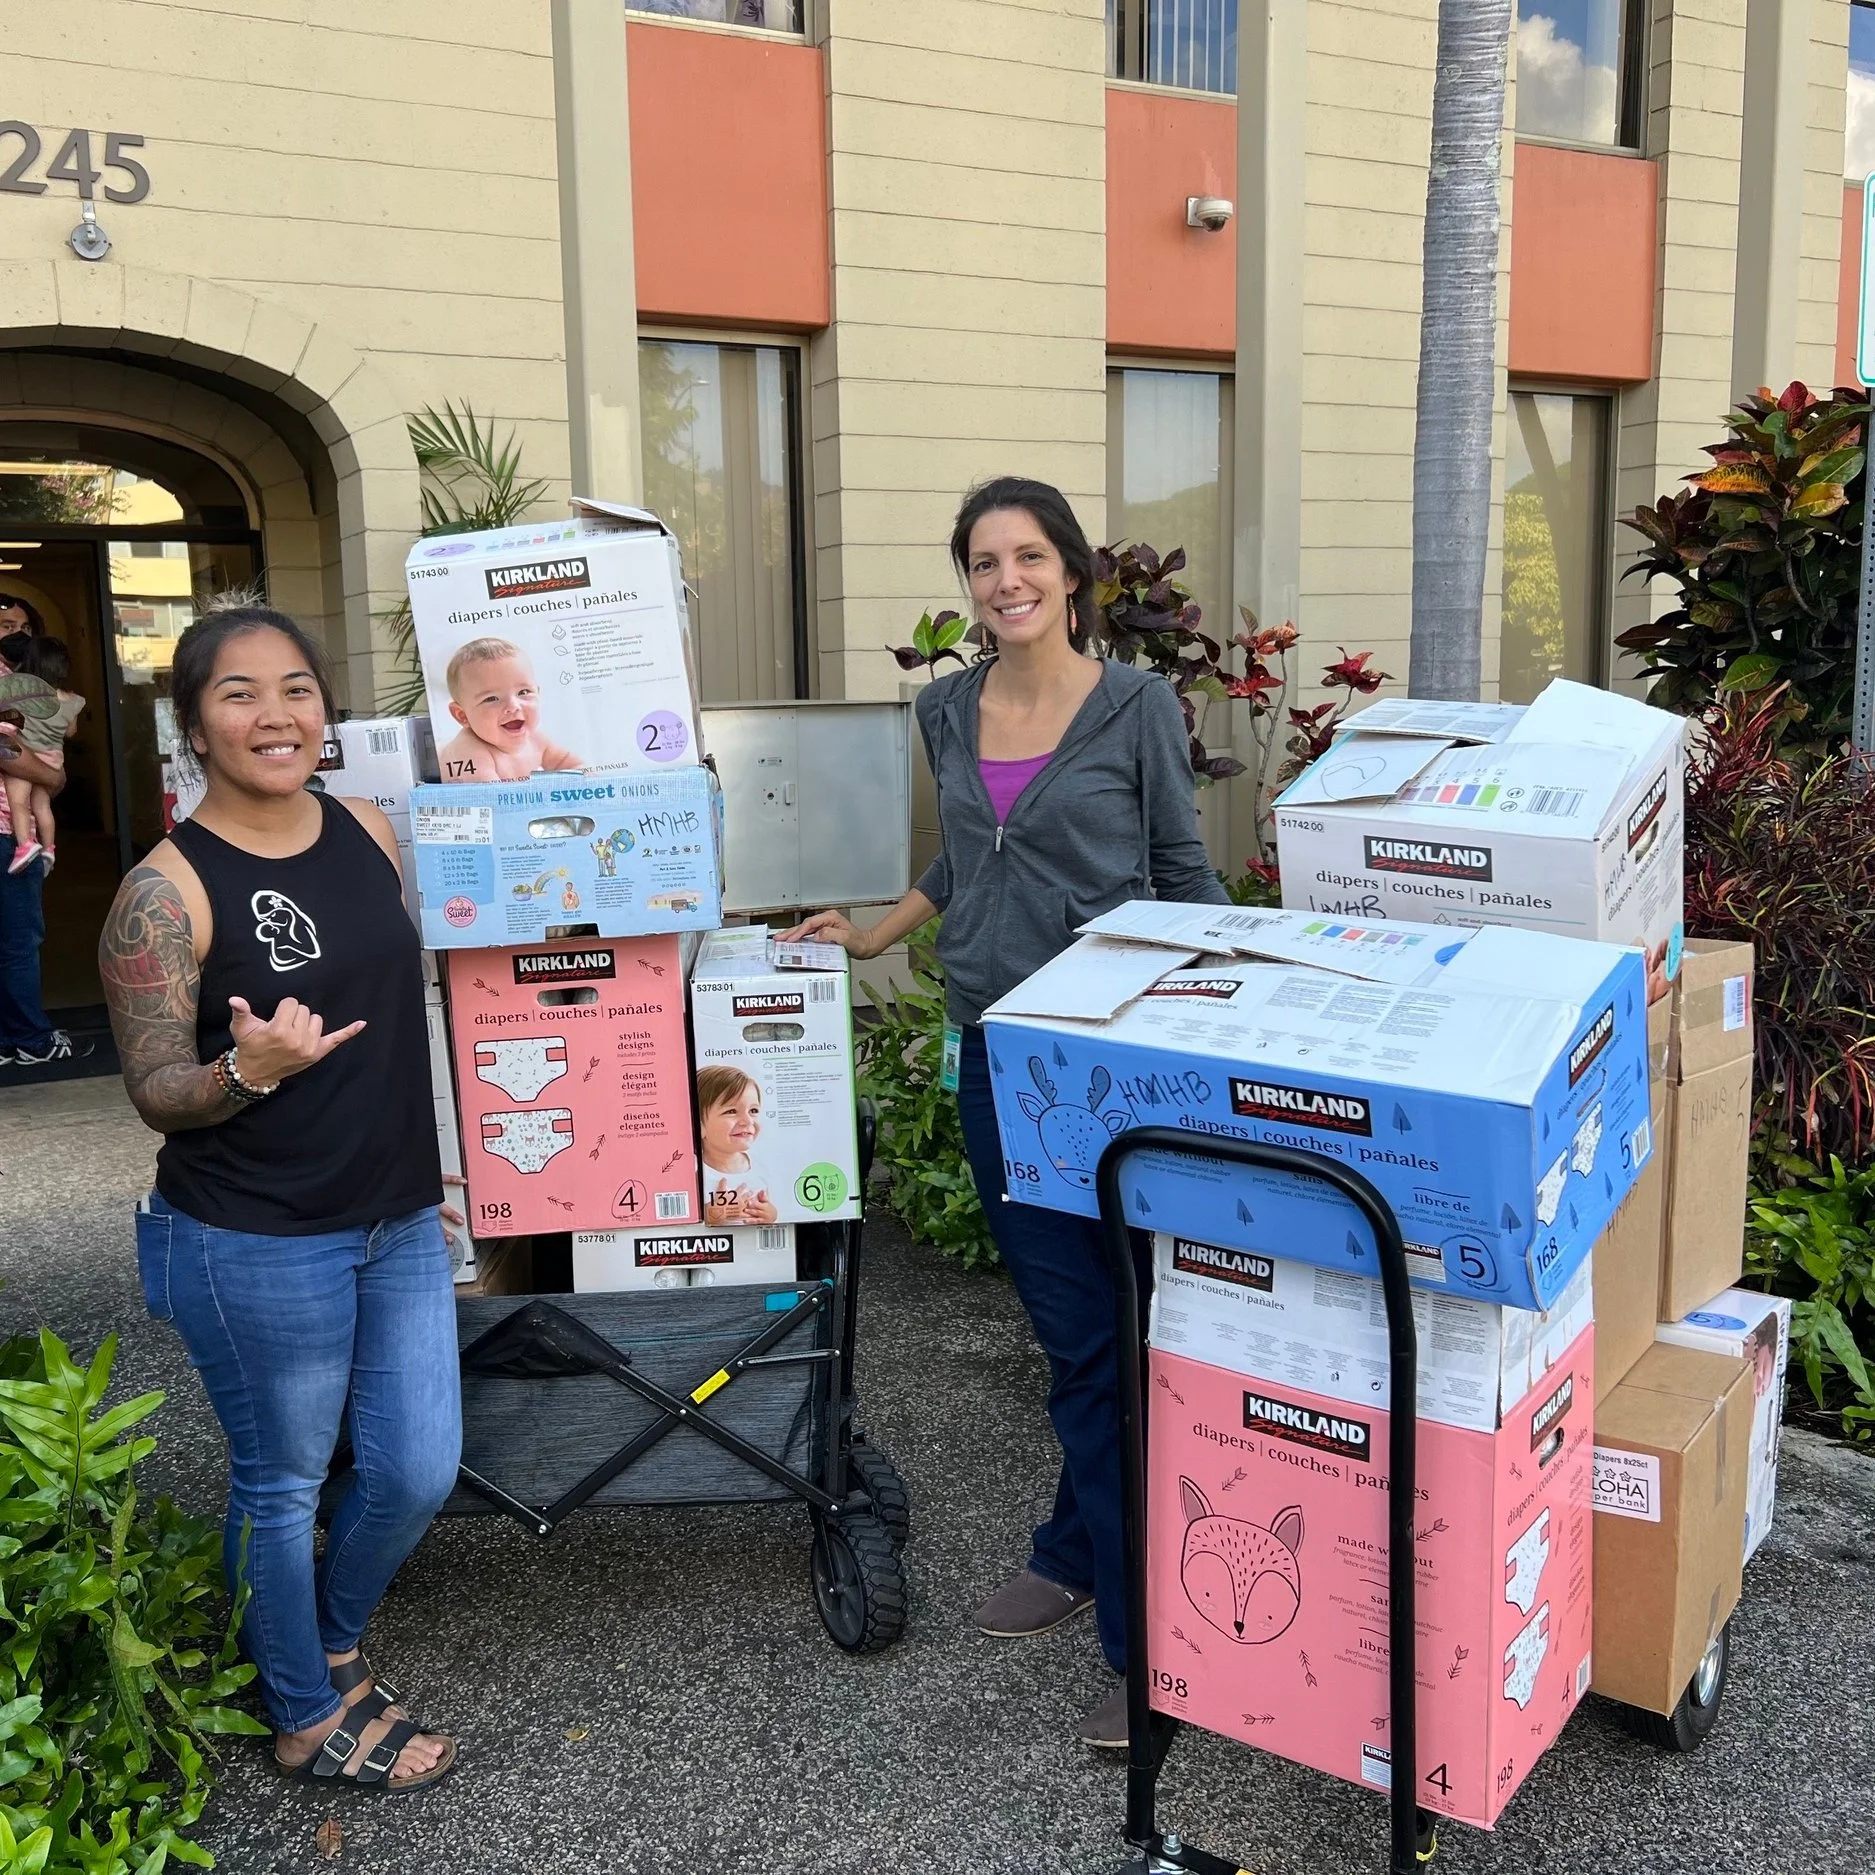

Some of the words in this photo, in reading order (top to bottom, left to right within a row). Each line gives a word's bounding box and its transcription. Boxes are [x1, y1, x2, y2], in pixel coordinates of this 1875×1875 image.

[0, 120, 150, 204] 245
[490, 561, 585, 588] KIRKLAND
[494, 579, 587, 598] Signature
[448, 608, 503, 625] diapers
[513, 599, 572, 617] couches
[582, 590, 639, 610] pañales
[642, 724, 661, 752] 2
[446, 759, 477, 778] 174
[497, 793, 544, 806] PREMIUM
[550, 784, 616, 802] sweet
[622, 783, 660, 797] ONIONS
[1629, 773, 1667, 837] KIRKLAND
[638, 810, 699, 838] HMHB
[1370, 840, 1488, 868] KIRKLAND
[1371, 857, 1487, 877] Signature
[1316, 871, 1379, 890] diapers
[1392, 880, 1465, 901] couches
[1480, 890, 1552, 910] pañales
[1608, 885, 1633, 921] diapers
[1635, 846, 1660, 884] couches
[447, 906, 474, 919] Sweet
[519, 952, 611, 973] KIRKLAND
[520, 969, 611, 983] Signature
[1153, 981, 1239, 992] IRKLAND
[474, 1012, 529, 1027] diapers
[539, 1008, 598, 1022] couches
[608, 1002, 663, 1019] pañales
[736, 995, 801, 1009] KIRKLAND
[617, 1041, 655, 1051] designs
[618, 1031, 651, 1042] stylish
[1570, 1009, 1613, 1073] KIRKLAND
[704, 1048, 743, 1059] diapers
[750, 1045, 791, 1055] couches
[798, 1043, 837, 1054] pañales
[622, 1072, 655, 1081] design
[1116, 1070, 1212, 1124] HMHB
[1236, 1082, 1365, 1120] KIRKLAND
[619, 1121, 666, 1131] elegantes
[623, 1112, 660, 1121] diseños
[1238, 1102, 1367, 1131] Signature
[1179, 1114, 1249, 1140] diapers
[1263, 1129, 1343, 1155] couches
[1359, 1146, 1440, 1172] pañales
[1619, 1130, 1631, 1169] 5
[1005, 1159, 1041, 1183] 168
[1293, 1173, 1324, 1185] sans
[619, 1186, 638, 1212] 4
[708, 1190, 739, 1206] 132
[803, 1174, 822, 1202] 6
[480, 1202, 512, 1220] 198
[1414, 1193, 1439, 1209] libre
[1453, 1201, 1471, 1213] de
[1478, 1217, 1489, 1227] de
[640, 1237, 730, 1255] KIRKLAND
[1536, 1236, 1559, 1274] 168
[640, 1253, 730, 1266] Signature
[1178, 1242, 1271, 1278] KIRKLAND
[1459, 1244, 1486, 1279] 5
[1178, 1260, 1269, 1287] Signature
[1160, 1273, 1195, 1289] diapers
[1201, 1283, 1240, 1300] couches
[1247, 1293, 1285, 1311] pañales
[1532, 1378, 1573, 1435] KIRKLAND
[1249, 1396, 1366, 1445] KIRKLAND
[1249, 1418, 1365, 1456] Signature
[1193, 1422, 1255, 1452] diapers
[1268, 1447, 1340, 1478] couches
[1355, 1470, 1429, 1501] pañes
[1593, 1451, 1622, 1464] Diapers
[1623, 1457, 1649, 1469] 8x25ct
[1507, 1491, 1536, 1526] diapers
[1538, 1457, 1564, 1492] couches
[1592, 1477, 1646, 1500] LOHA
[1594, 1494, 1613, 1503] per
[1618, 1496, 1646, 1509] bank
[1337, 1535, 1374, 1552] made
[1359, 1637, 1391, 1657] libre
[1152, 1668, 1188, 1698] 198
[1425, 1763, 1453, 1797] 4
[1496, 1757, 1514, 1794] 198
